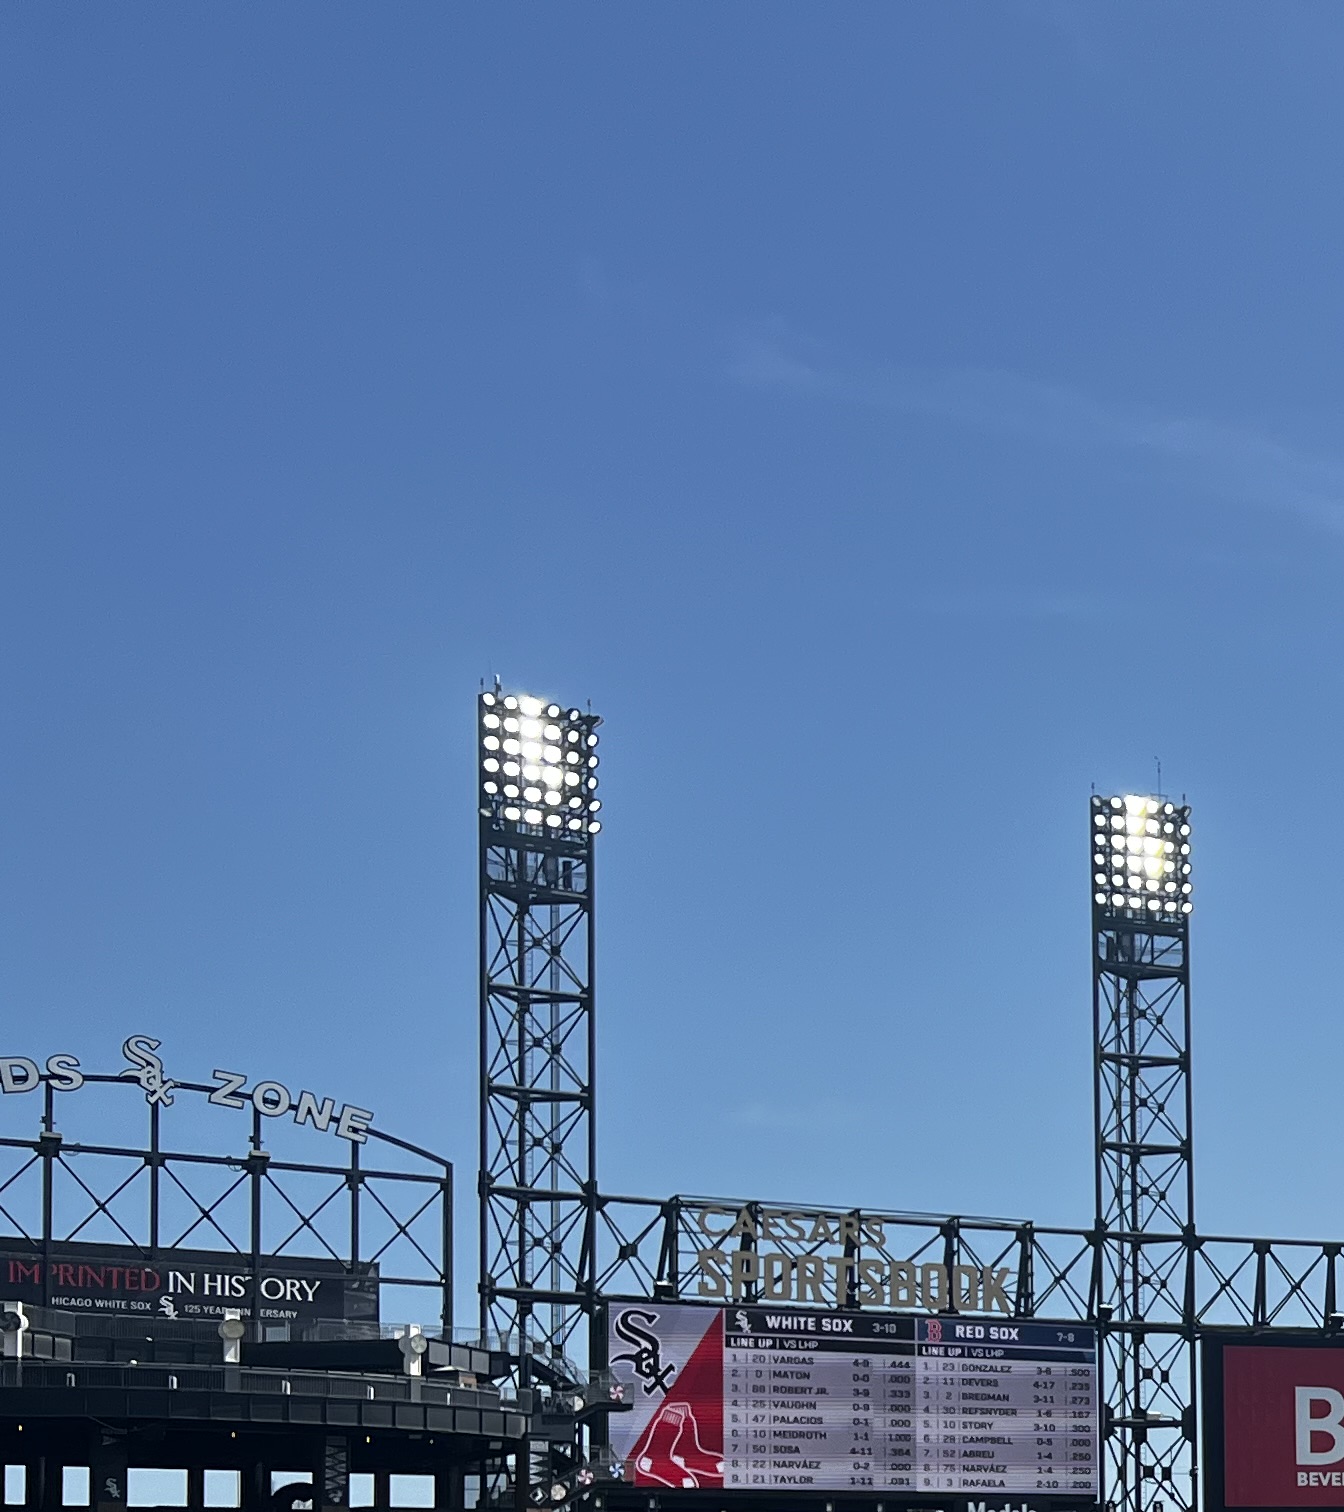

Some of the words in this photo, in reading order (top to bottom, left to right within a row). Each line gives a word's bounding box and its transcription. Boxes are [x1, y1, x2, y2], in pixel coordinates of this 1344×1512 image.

[208, 1069, 374, 1144] ZONE
[698, 1207, 886, 1249] CAESARS
[168, 1271, 195, 1294] IN
[204, 1273, 321, 1302] HISORY
[698, 1249, 1011, 1317] SPORTSBOOK
[52, 1297, 92, 1307] HICAGO
[95, 1299, 127, 1309] WHITE
[131, 1301, 151, 1310] SOX
[184, 1305, 200, 1313] 125
[766, 1315, 816, 1331] WHITE
[821, 1318, 853, 1333] SOX
[872, 1323, 896, 1334] 3-10
[955, 1325, 984, 1338] RED
[990, 1328, 1019, 1340] SOX
[731, 1338, 754, 1347] LINE
[758, 1339, 773, 1347] UP
[922, 1347, 944, 1355] LINE
[948, 1348, 961, 1356] UP
[773, 1370, 810, 1379] MATON
[773, 1386, 813, 1394] ROBERT
[773, 1401, 817, 1410] VAUGHN
[753, 1415, 765, 1423] 47
[773, 1416, 823, 1424] PALACIOS
[962, 1422, 993, 1430] STORY
[773, 1431, 827, 1439] MEIDROTH
[753, 1460, 766, 1468] 22
[753, 1475, 765, 1483] 21
[774, 1476, 813, 1484] TAYLOR
